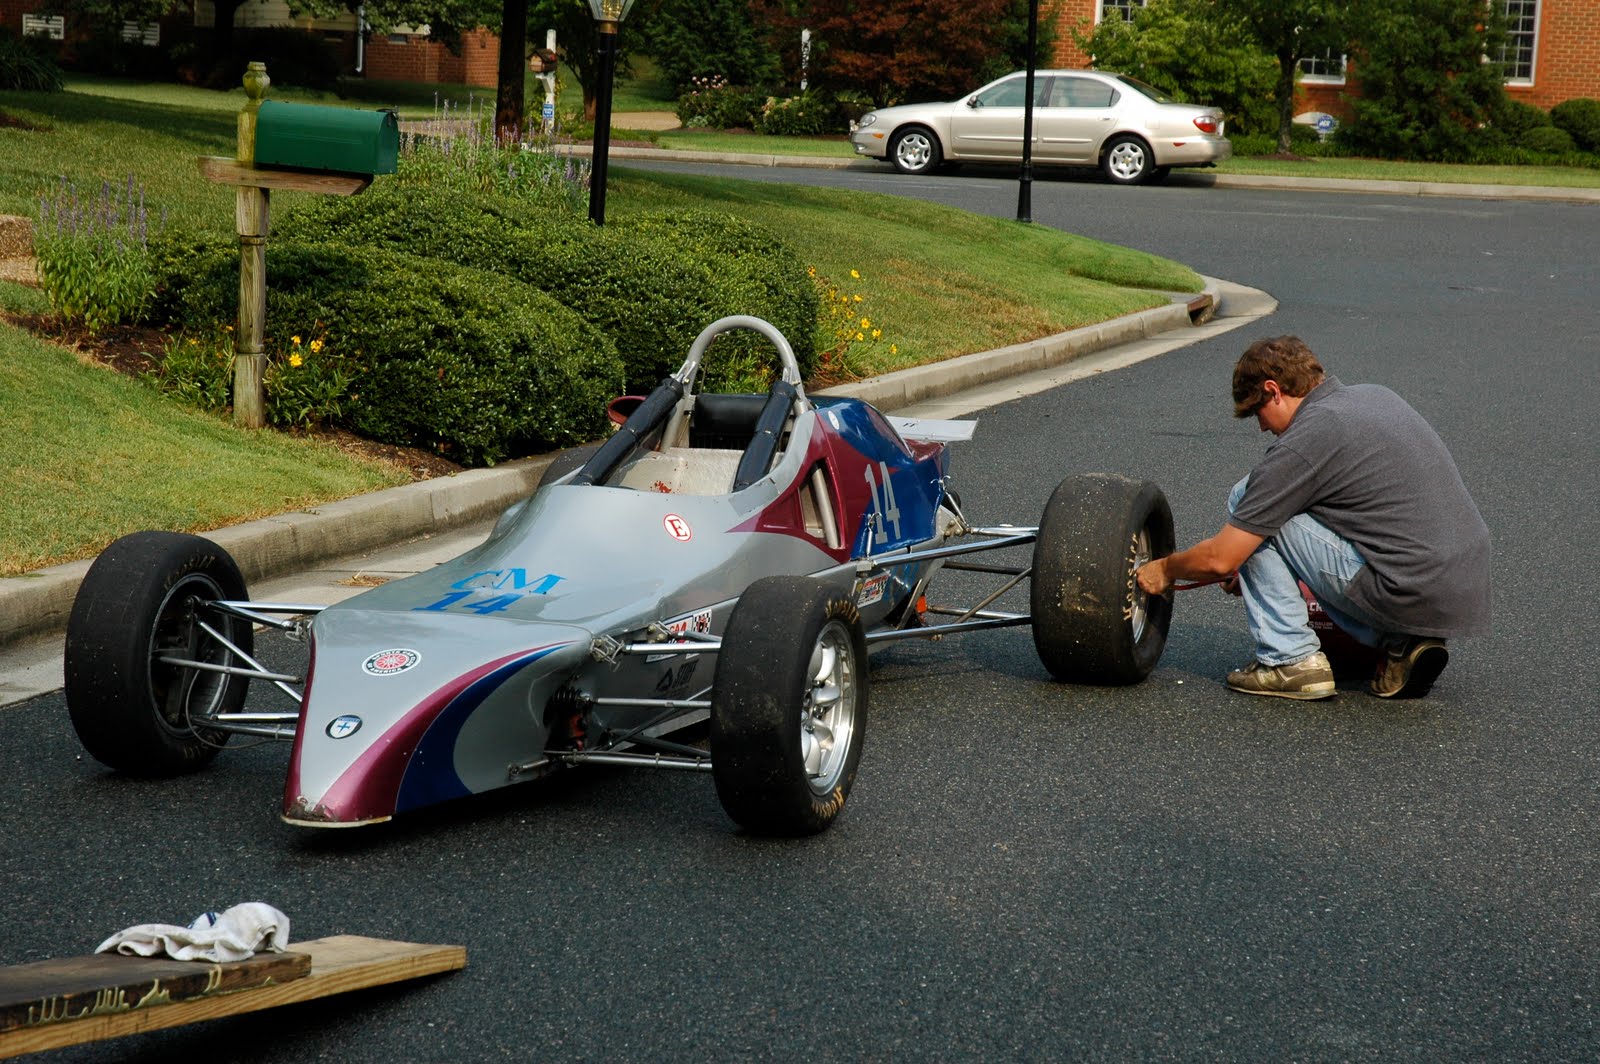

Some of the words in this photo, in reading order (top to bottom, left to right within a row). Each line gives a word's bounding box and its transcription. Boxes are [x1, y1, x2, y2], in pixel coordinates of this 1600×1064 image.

[864, 461, 901, 545] 14
[667, 518, 688, 538] E
[450, 567, 568, 595] CM
[411, 590, 525, 615] 14
[1309, 602, 1322, 612] CR
